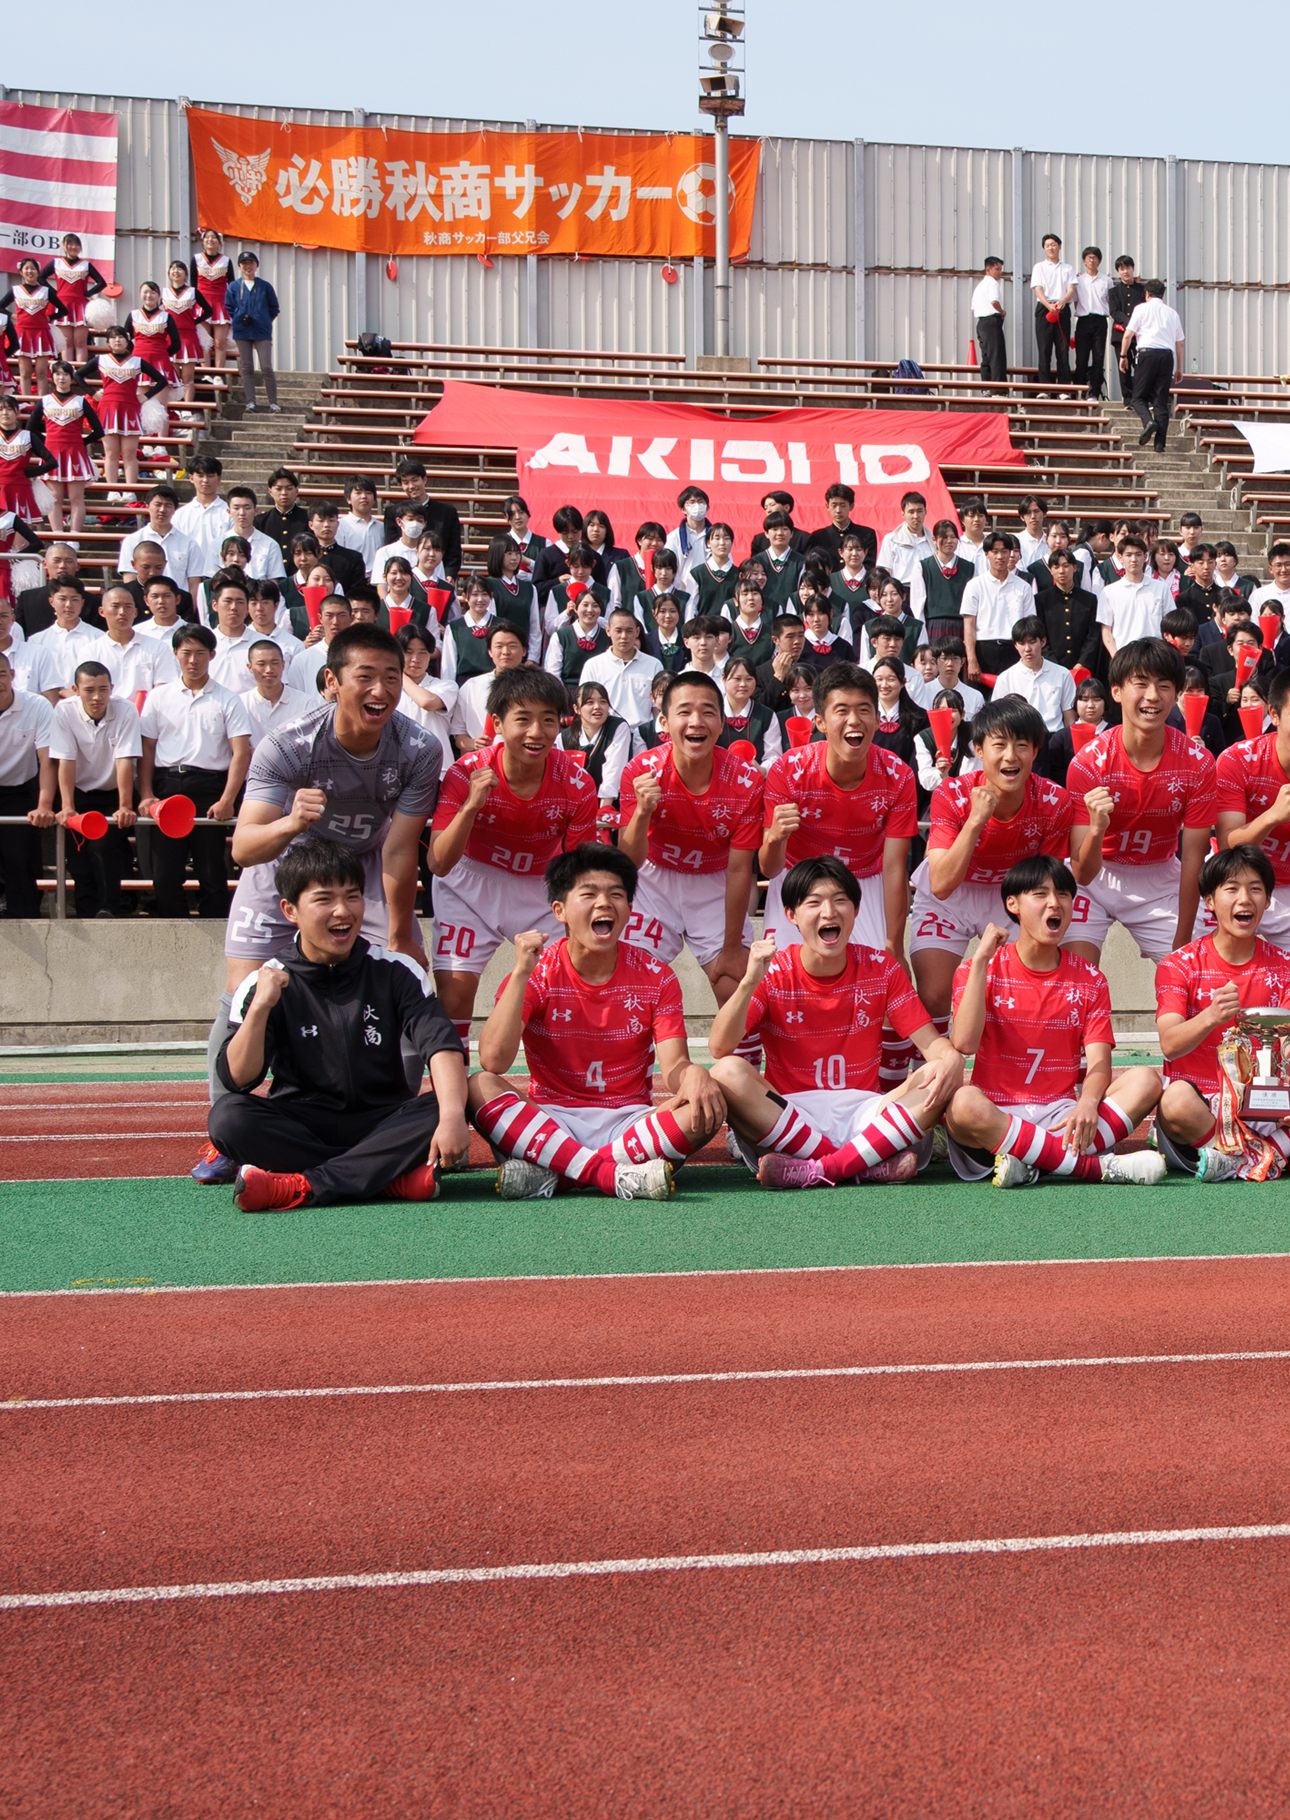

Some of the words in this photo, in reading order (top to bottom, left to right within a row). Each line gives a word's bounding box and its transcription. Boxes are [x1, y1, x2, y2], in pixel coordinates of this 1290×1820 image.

[275, 153, 672, 222] 必勝秋商サッカー
[423, 231, 550, 246] 秋商サッカー部父兄会
[328, 814, 375, 839] 25
[1120, 830, 1152, 854] 19
[491, 845, 533, 873] 20
[662, 843, 704, 868] 24
[230, 906, 277, 944] 25
[437, 922, 475, 958] 20
[624, 911, 663, 949] 24
[917, 912, 956, 939] 22
[585, 1060, 606, 1092] 4
[813, 1054, 846, 1089] 10
[1024, 1048, 1045, 1084] 7
